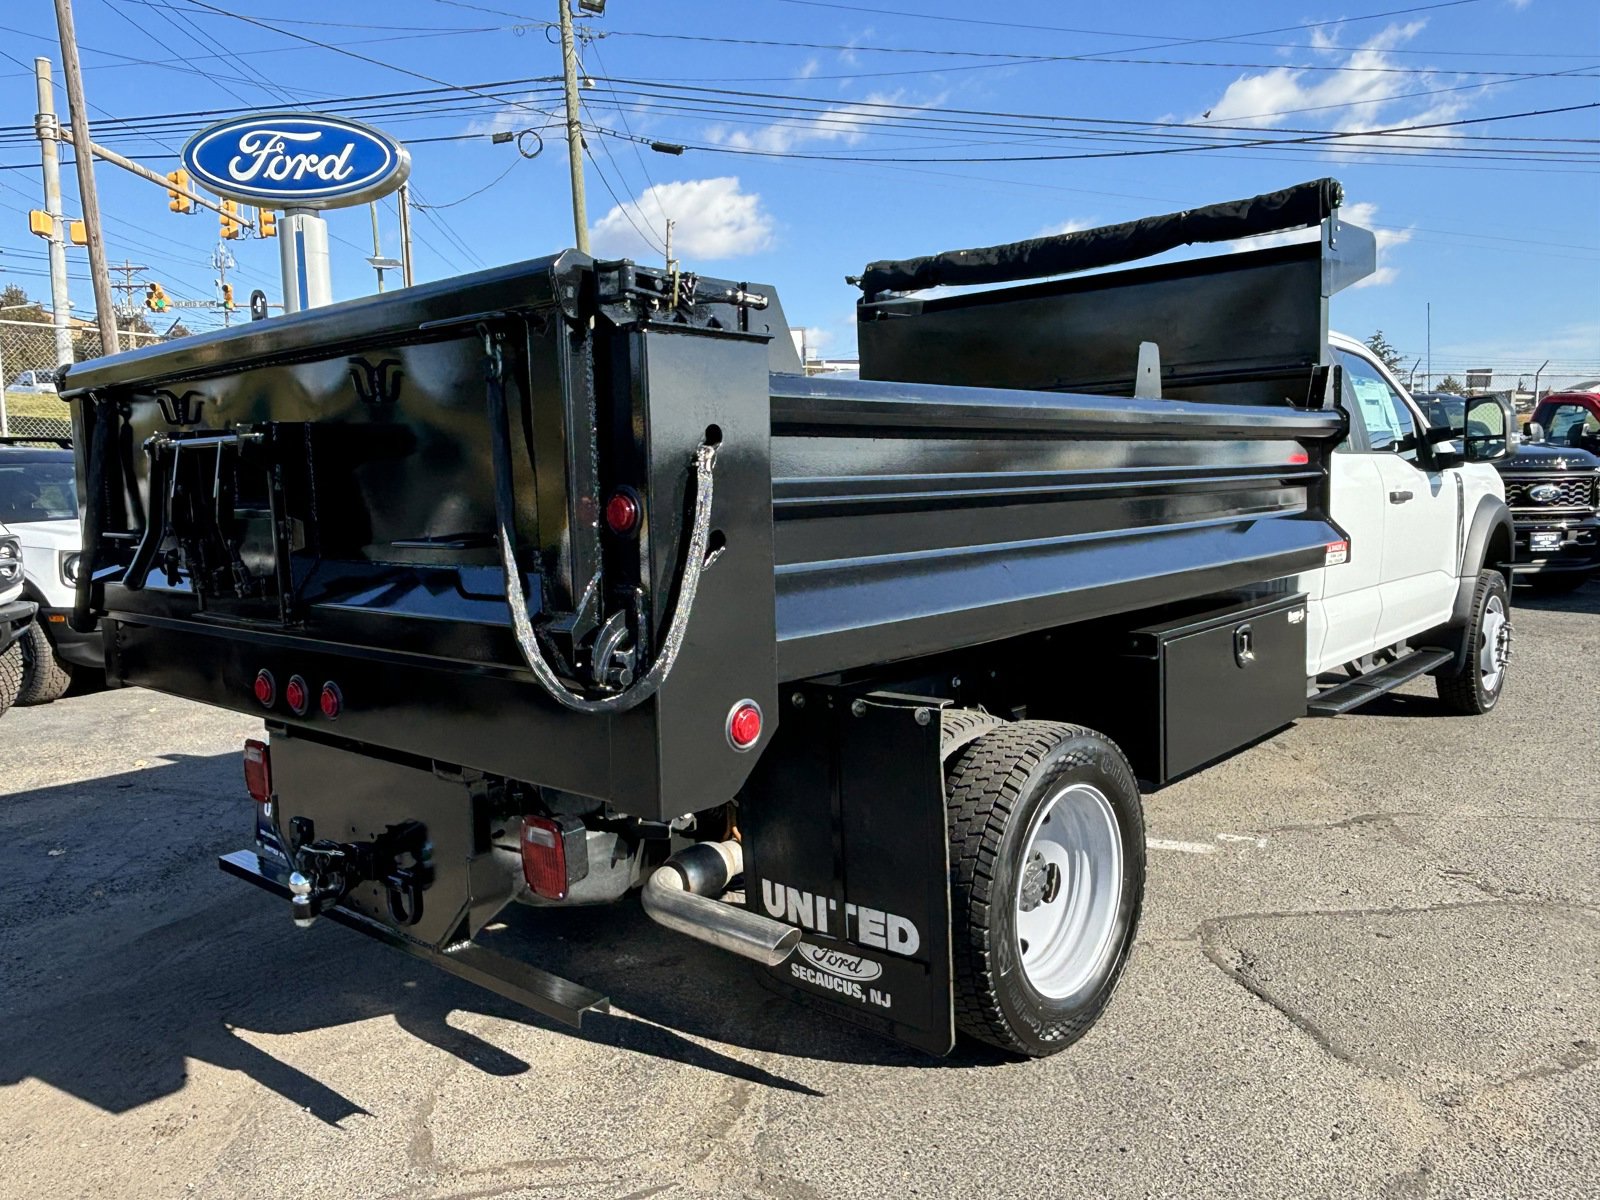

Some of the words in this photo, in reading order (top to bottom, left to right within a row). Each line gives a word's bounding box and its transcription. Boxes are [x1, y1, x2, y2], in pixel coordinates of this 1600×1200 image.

[228, 129, 355, 182] Ford
[812, 948, 863, 974] Ford
[791, 963, 867, 1003] SECAUCUS,
[870, 988, 892, 1008] NJ
